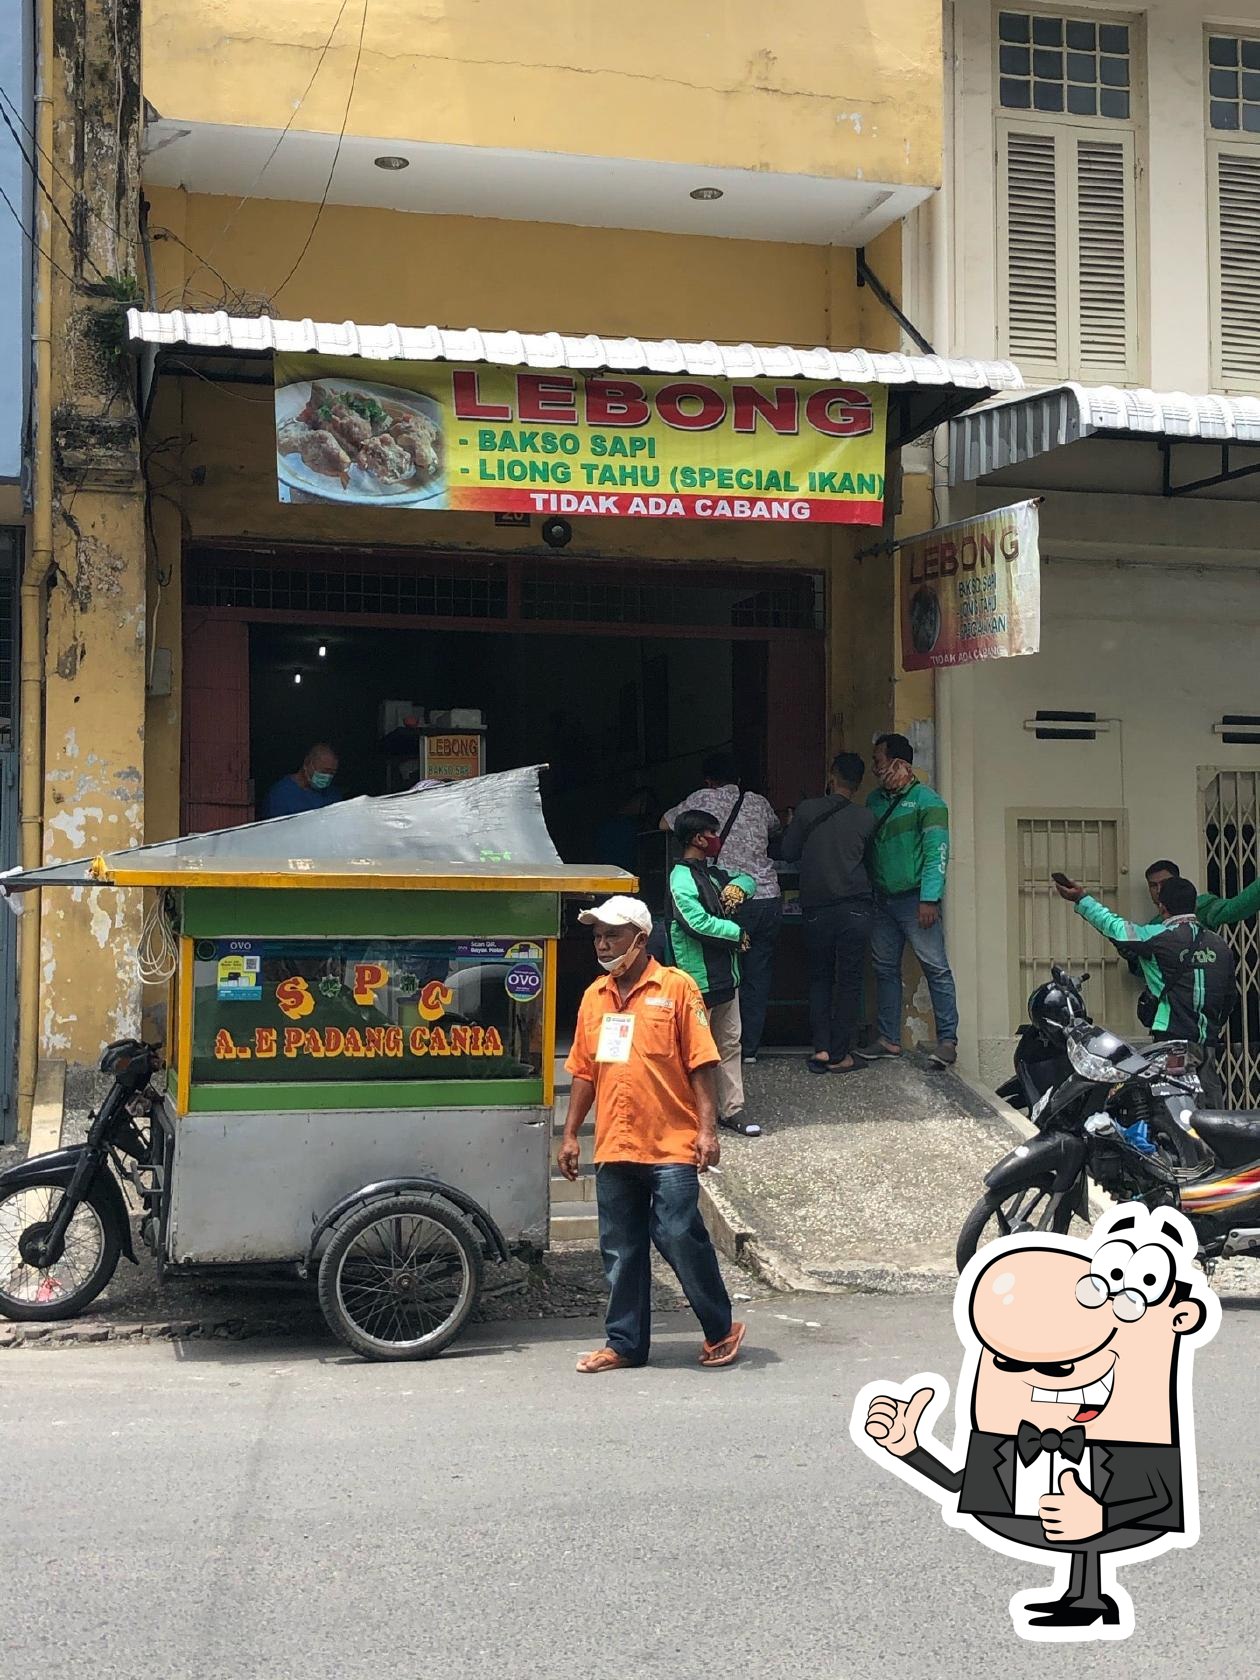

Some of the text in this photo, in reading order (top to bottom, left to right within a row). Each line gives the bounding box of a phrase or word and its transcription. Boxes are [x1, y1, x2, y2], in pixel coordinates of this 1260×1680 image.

[453, 370, 873, 437] LEBONG
[478, 429, 580, 454] BAKSO
[590, 434, 656, 458] SAPI
[479, 459, 572, 483] LIONG
[580, 463, 660, 487] TAHU
[670, 466, 799, 493] (SPECIAL
[808, 472, 885, 500] IKAN)
[530, 493, 811, 519] TIDAK ADA CABANG
[910, 525, 1019, 585] LEBONG
[429, 738, 479, 756] LEBONG
[230, 941, 252, 950] OVO
[275, 963, 453, 1021] S P C
[508, 974, 540, 986] OVO
[284, 1026, 404, 1058] PADANG
[410, 1025, 504, 1057] CANIA
